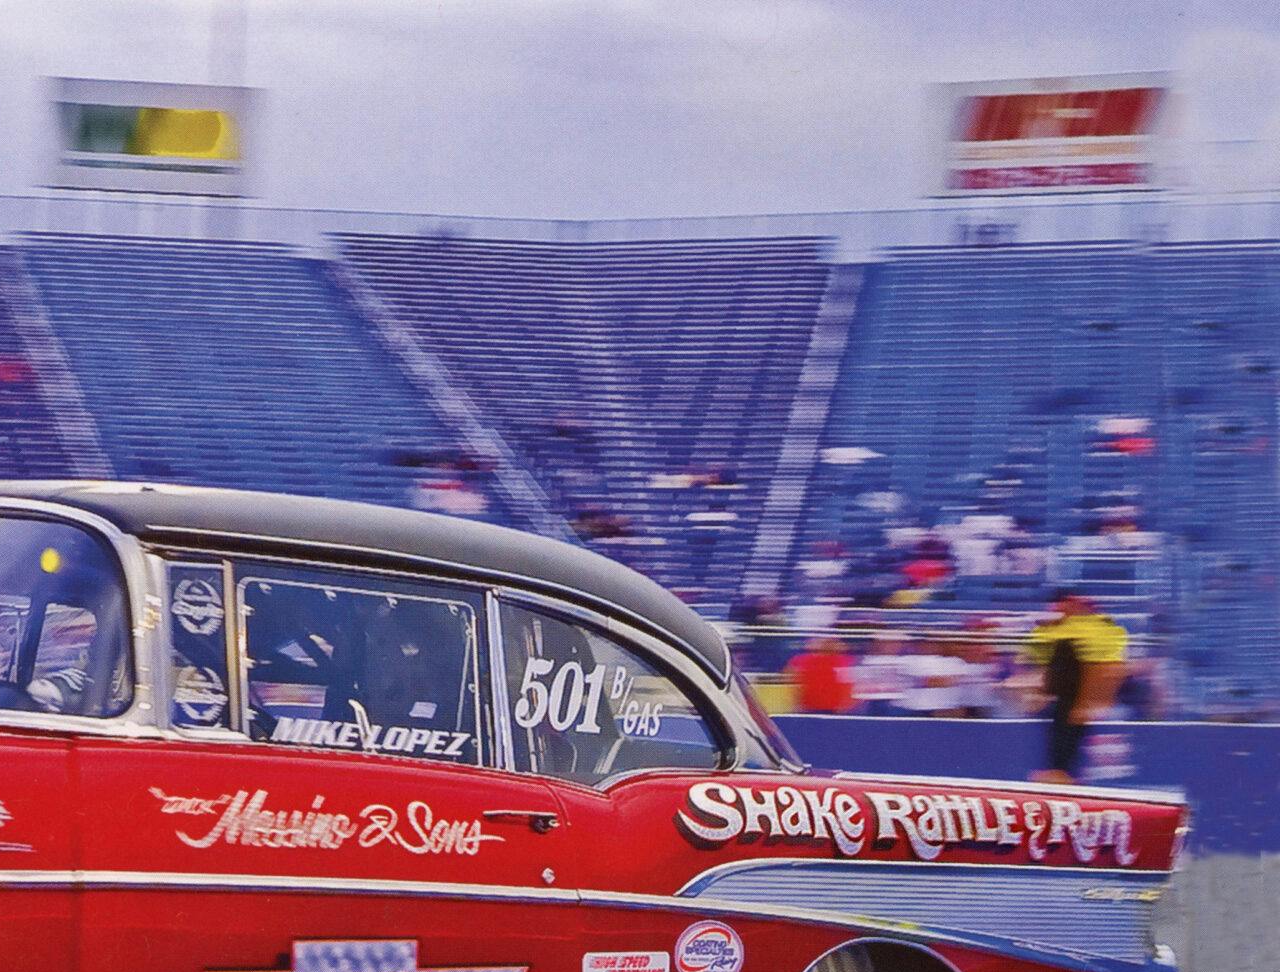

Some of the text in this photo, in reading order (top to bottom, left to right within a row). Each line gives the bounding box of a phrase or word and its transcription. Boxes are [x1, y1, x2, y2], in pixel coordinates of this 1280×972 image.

[515, 657, 606, 734] 501
[271, 717, 470, 755] MIKE LOPEZ
[358, 803, 399, 849] &
[395, 800, 505, 855] Sons
